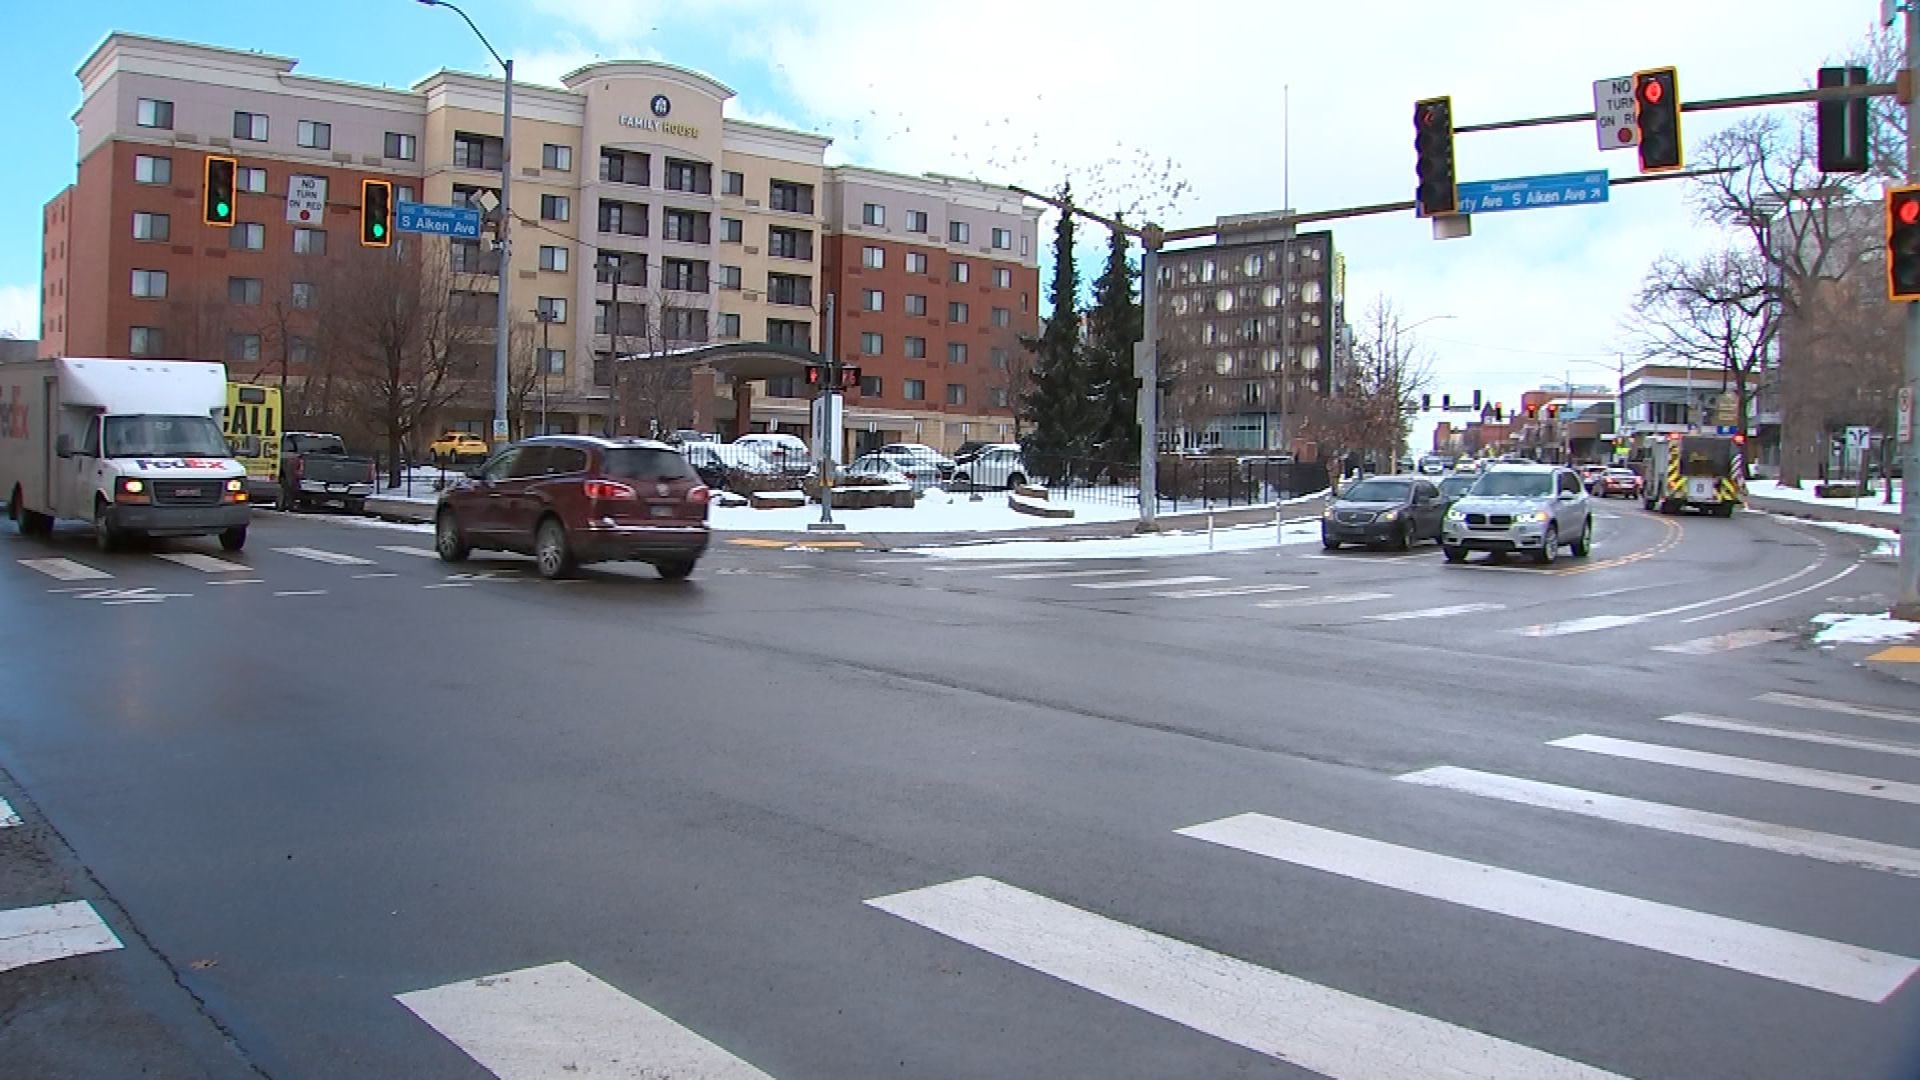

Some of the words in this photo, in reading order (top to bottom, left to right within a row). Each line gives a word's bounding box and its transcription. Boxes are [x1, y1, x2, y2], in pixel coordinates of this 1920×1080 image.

[1612, 80, 1631, 94] NO
[618, 114, 660, 132] FAMILY
[661, 120, 699, 138] HOUSE
[1600, 115, 1616, 128] ON
[301, 180, 316, 189] NO
[296, 189, 318, 199] TURN
[1482, 194, 1503, 209] Ave
[1512, 191, 1522, 205] S
[1526, 190, 1560, 206] Aiken
[1564, 187, 1587, 201] Ave
[289, 199, 300, 209] ON
[306, 201, 322, 211] RED
[401, 215, 411, 227] S
[415, 217, 450, 233] Aiken
[453, 221, 477, 235] Ave
[136, 458, 227, 471] FedEx
